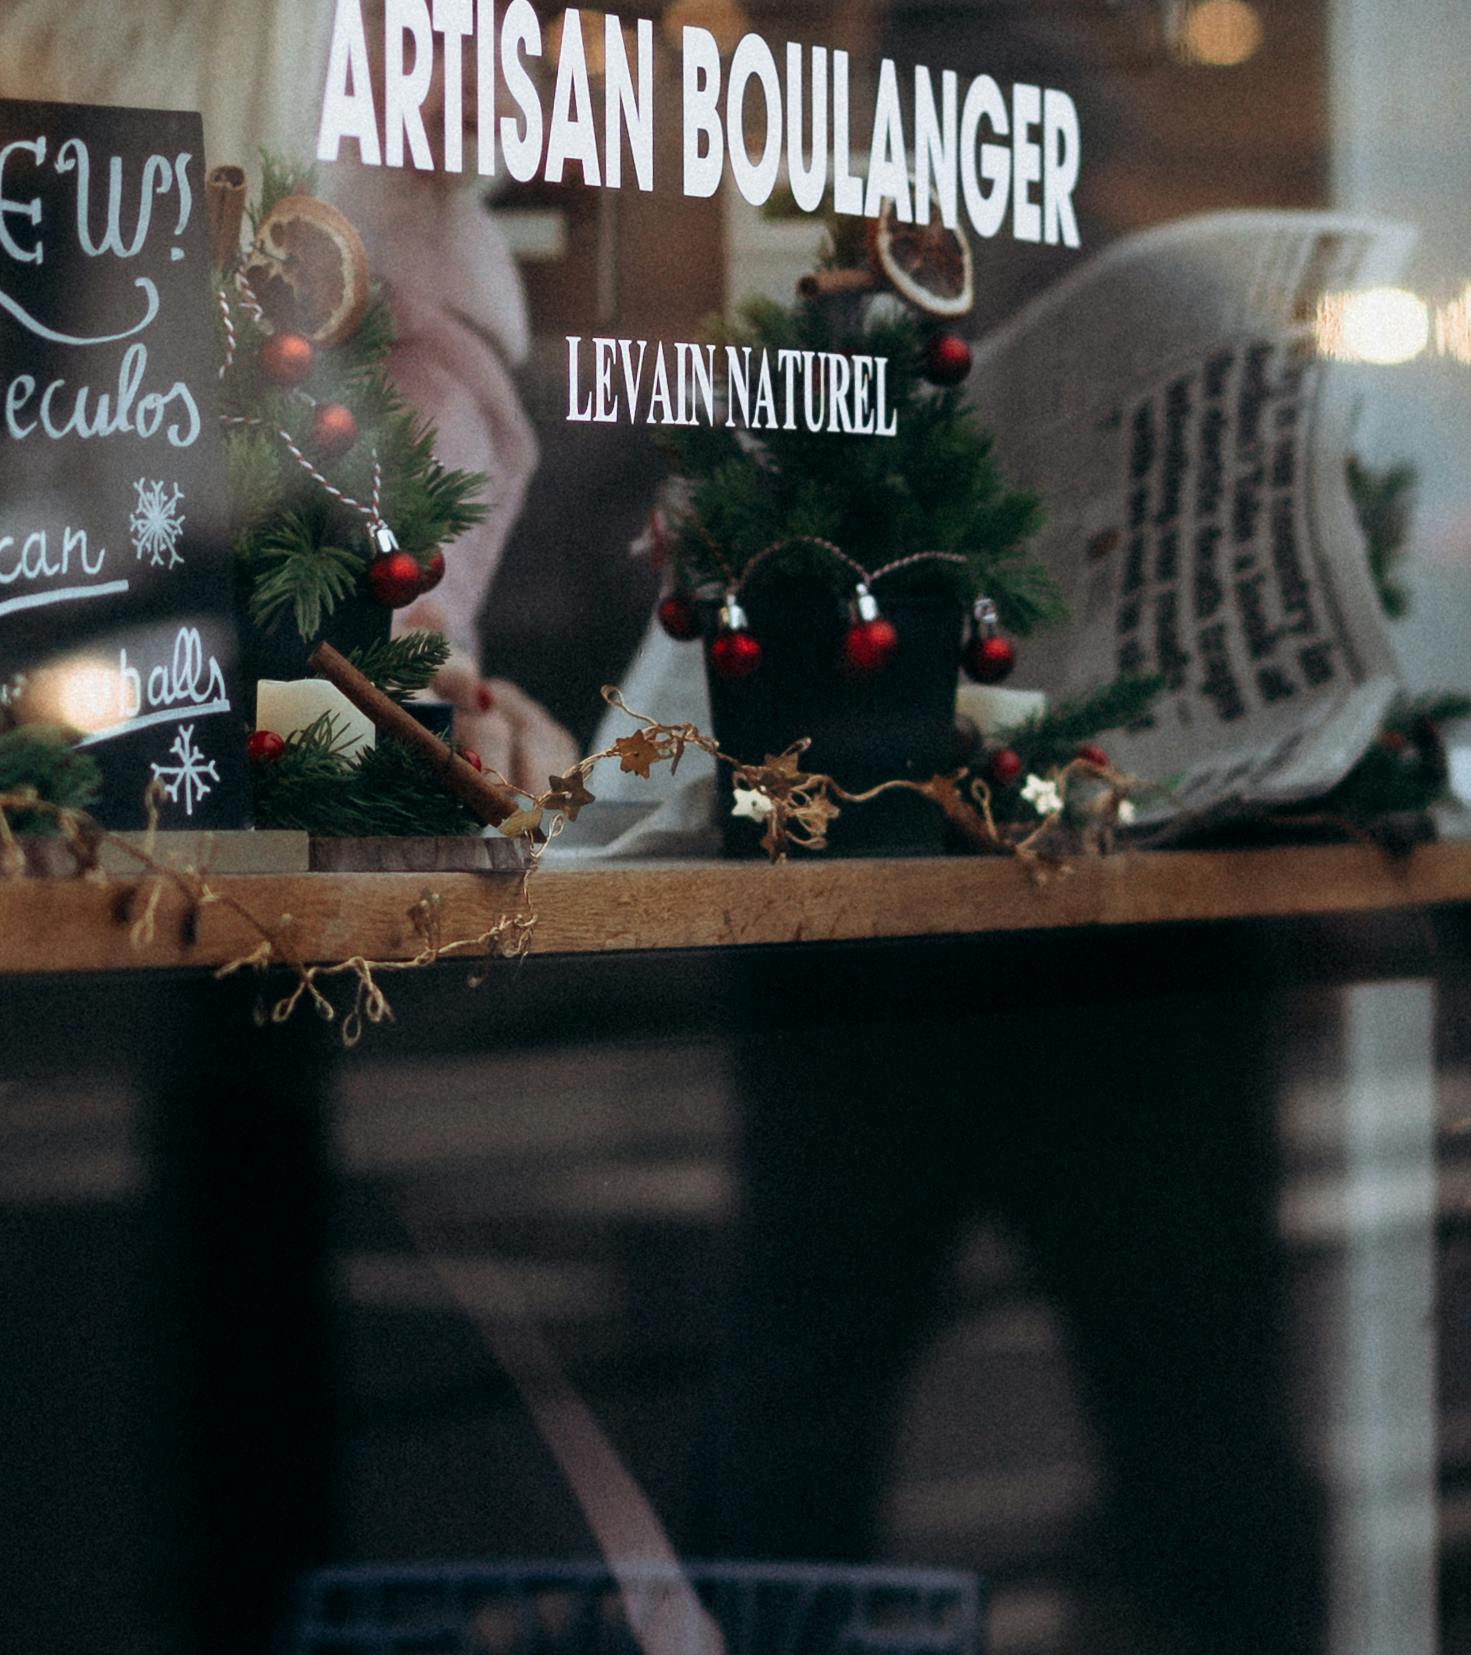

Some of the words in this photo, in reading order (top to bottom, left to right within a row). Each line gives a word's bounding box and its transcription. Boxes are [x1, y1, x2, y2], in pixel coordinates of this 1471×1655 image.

[681, 25, 1081, 249] BOULANGER
[564, 335, 716, 427] LEVAIN
[725, 345, 898, 437] NATUREL
